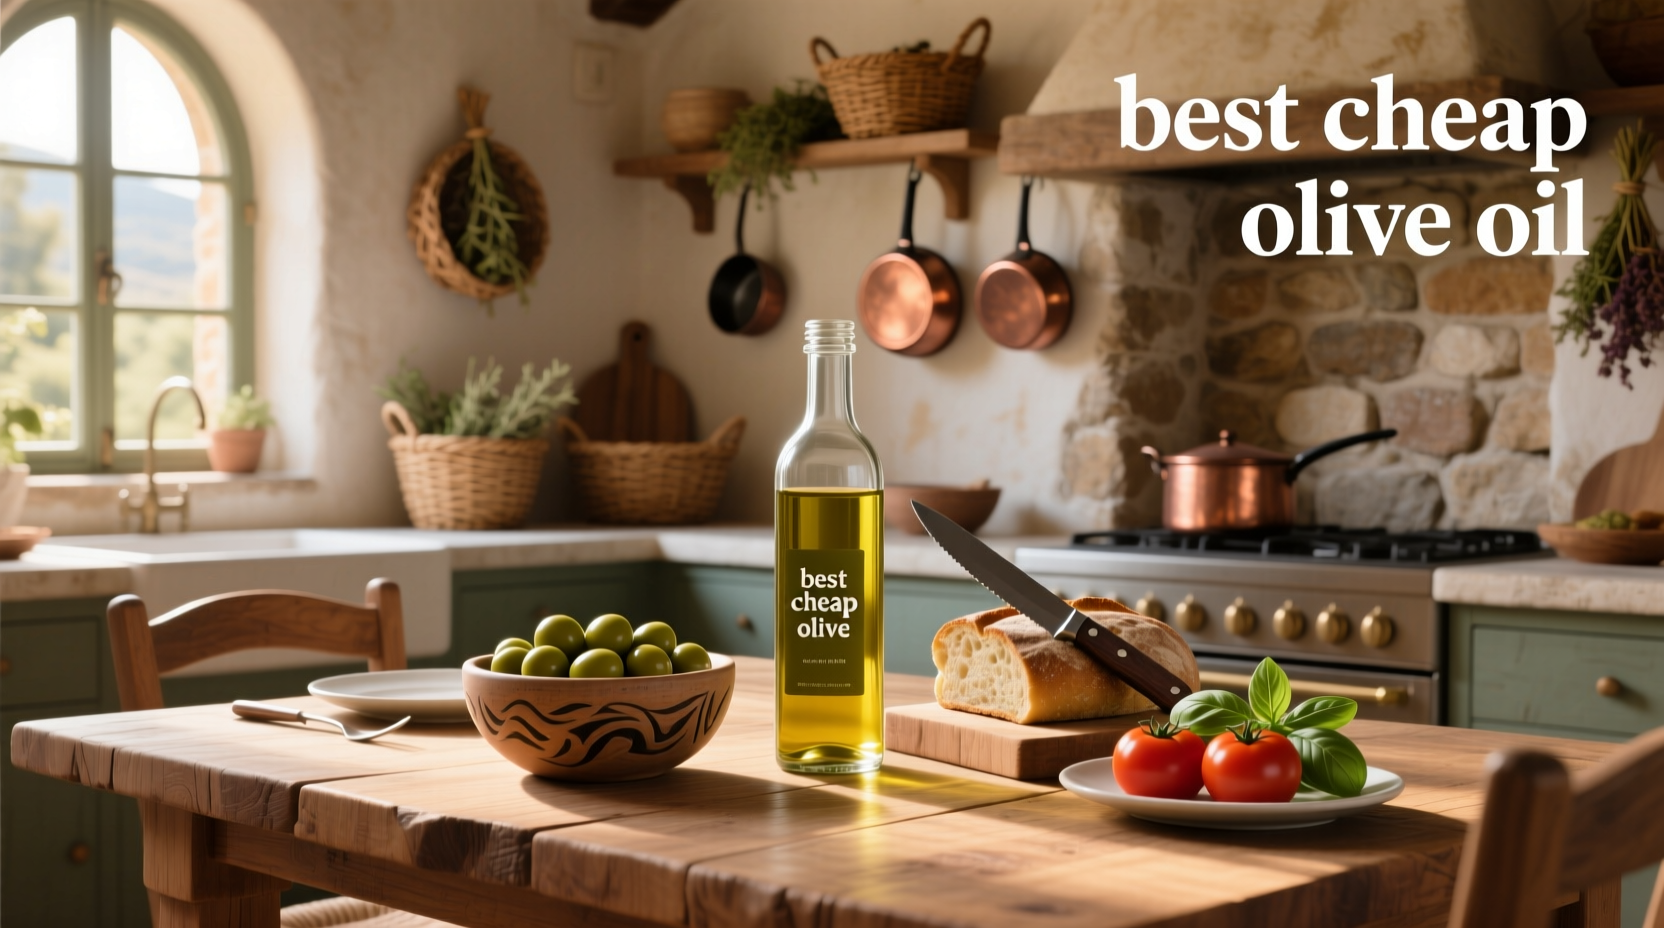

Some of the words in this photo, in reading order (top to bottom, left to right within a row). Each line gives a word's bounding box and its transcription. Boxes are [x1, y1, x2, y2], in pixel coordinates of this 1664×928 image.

[800, 567, 848, 589] best
[790, 590, 858, 619] cheap
[796, 615, 851, 639] olive
